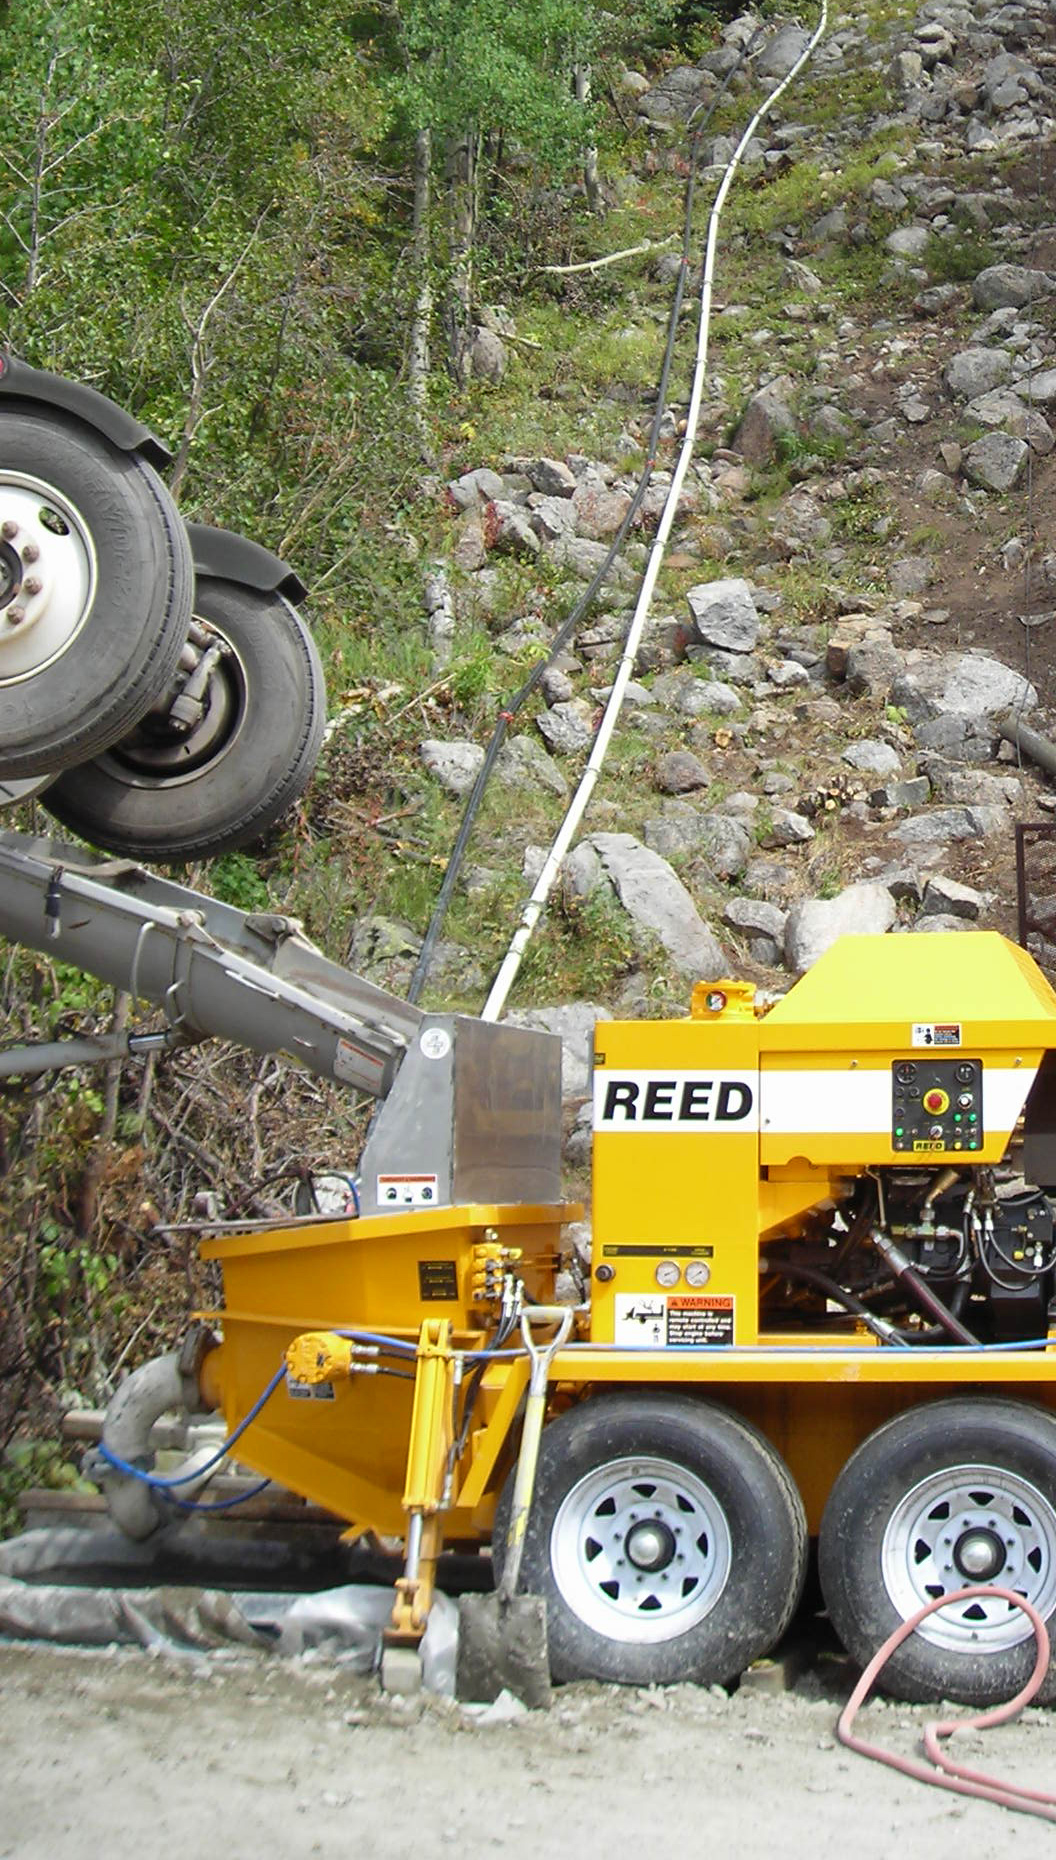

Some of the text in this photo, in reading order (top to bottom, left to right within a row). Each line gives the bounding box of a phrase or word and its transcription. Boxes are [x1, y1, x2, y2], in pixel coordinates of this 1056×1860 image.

[602, 1081, 753, 1121] REED
[915, 1142, 943, 1150] REED
[681, 1298, 731, 1307] WARNING
